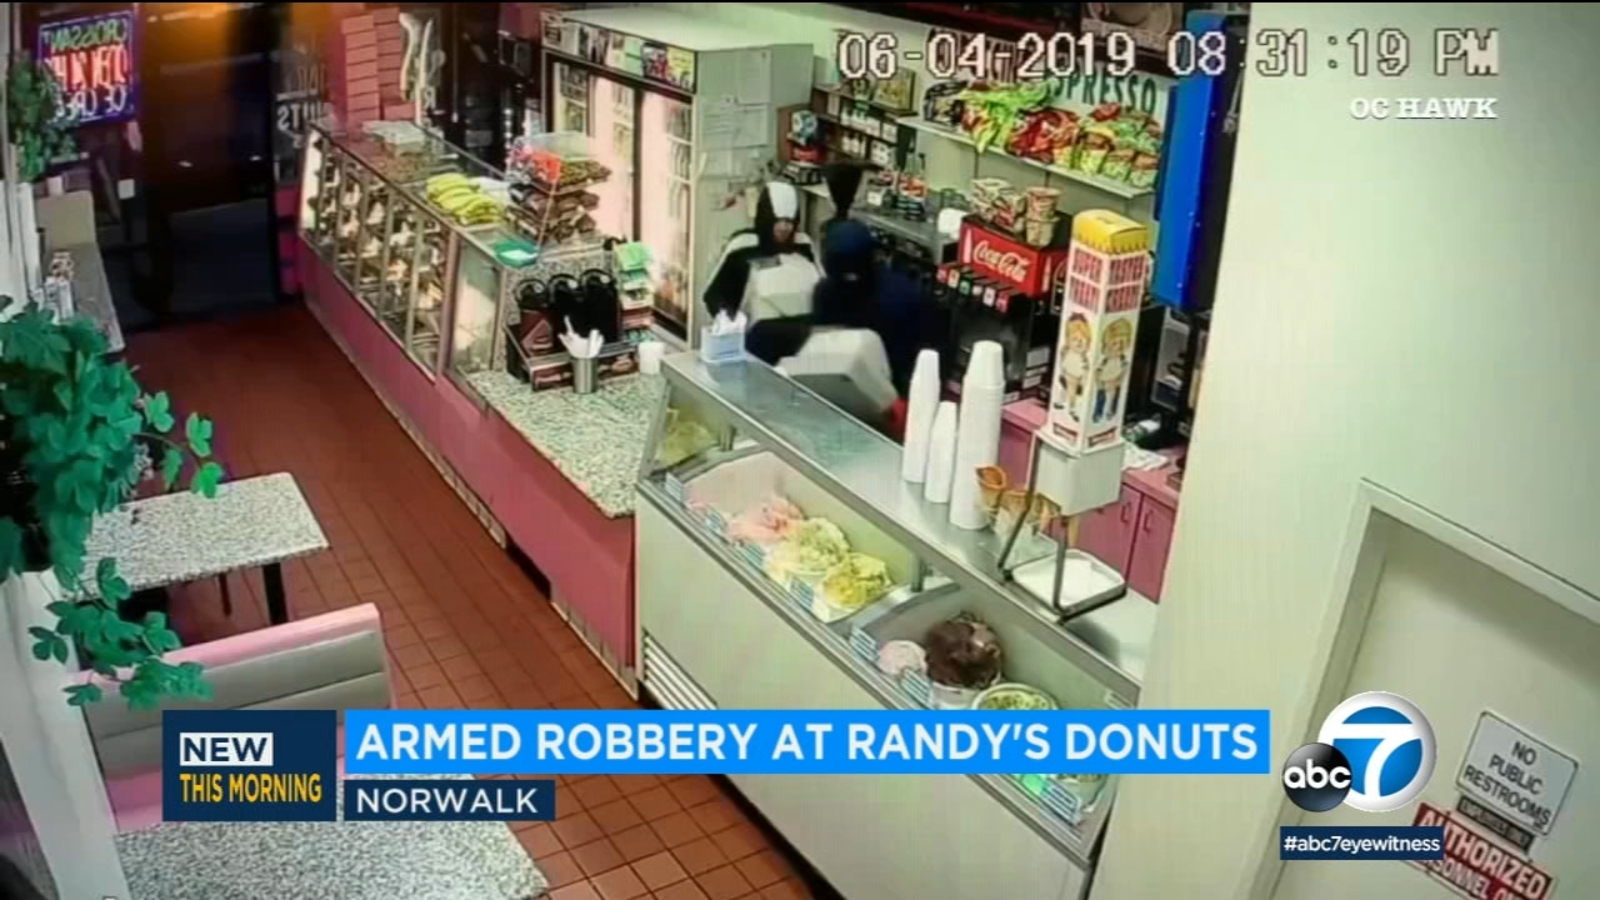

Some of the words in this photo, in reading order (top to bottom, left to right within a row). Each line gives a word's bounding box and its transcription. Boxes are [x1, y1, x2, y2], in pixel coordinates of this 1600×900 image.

[1511, 740, 1537, 766] NO
[1489, 754, 1542, 795] PUBLIC
[1464, 765, 1551, 826] RESTROOMS
